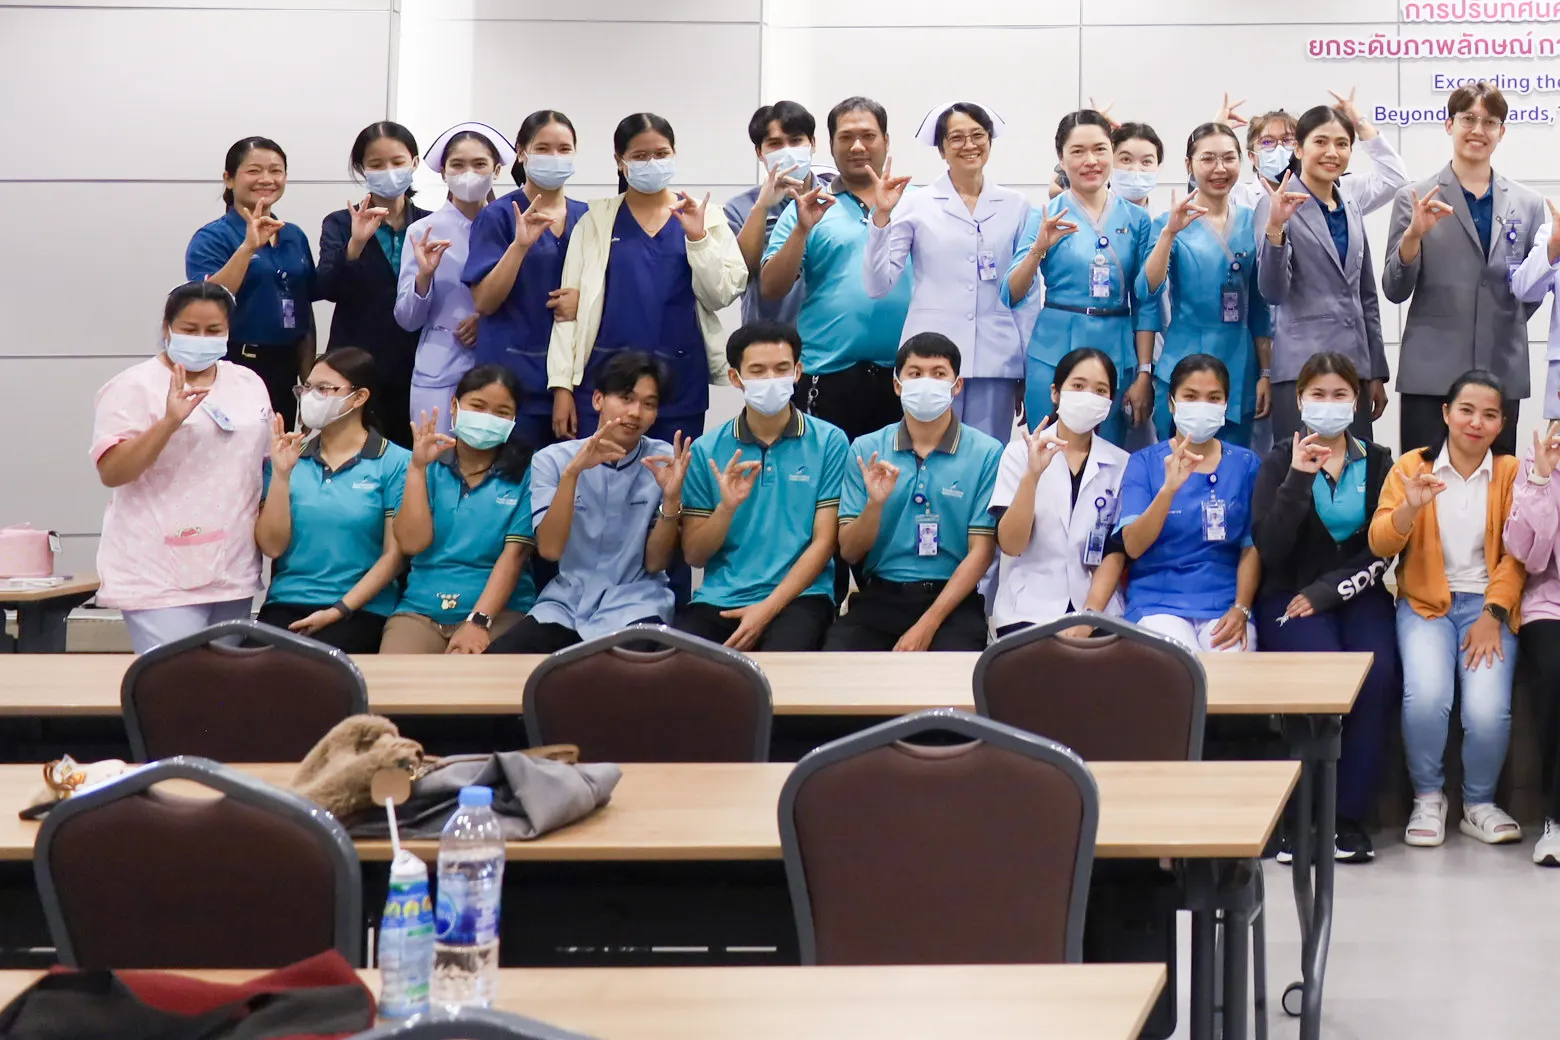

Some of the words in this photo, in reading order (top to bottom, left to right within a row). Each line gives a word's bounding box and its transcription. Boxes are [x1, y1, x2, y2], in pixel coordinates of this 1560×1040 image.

[1308, 30, 1533, 57] ยกระดับภาพลักษณ์
[1374, 105, 1446, 125] Beyond
